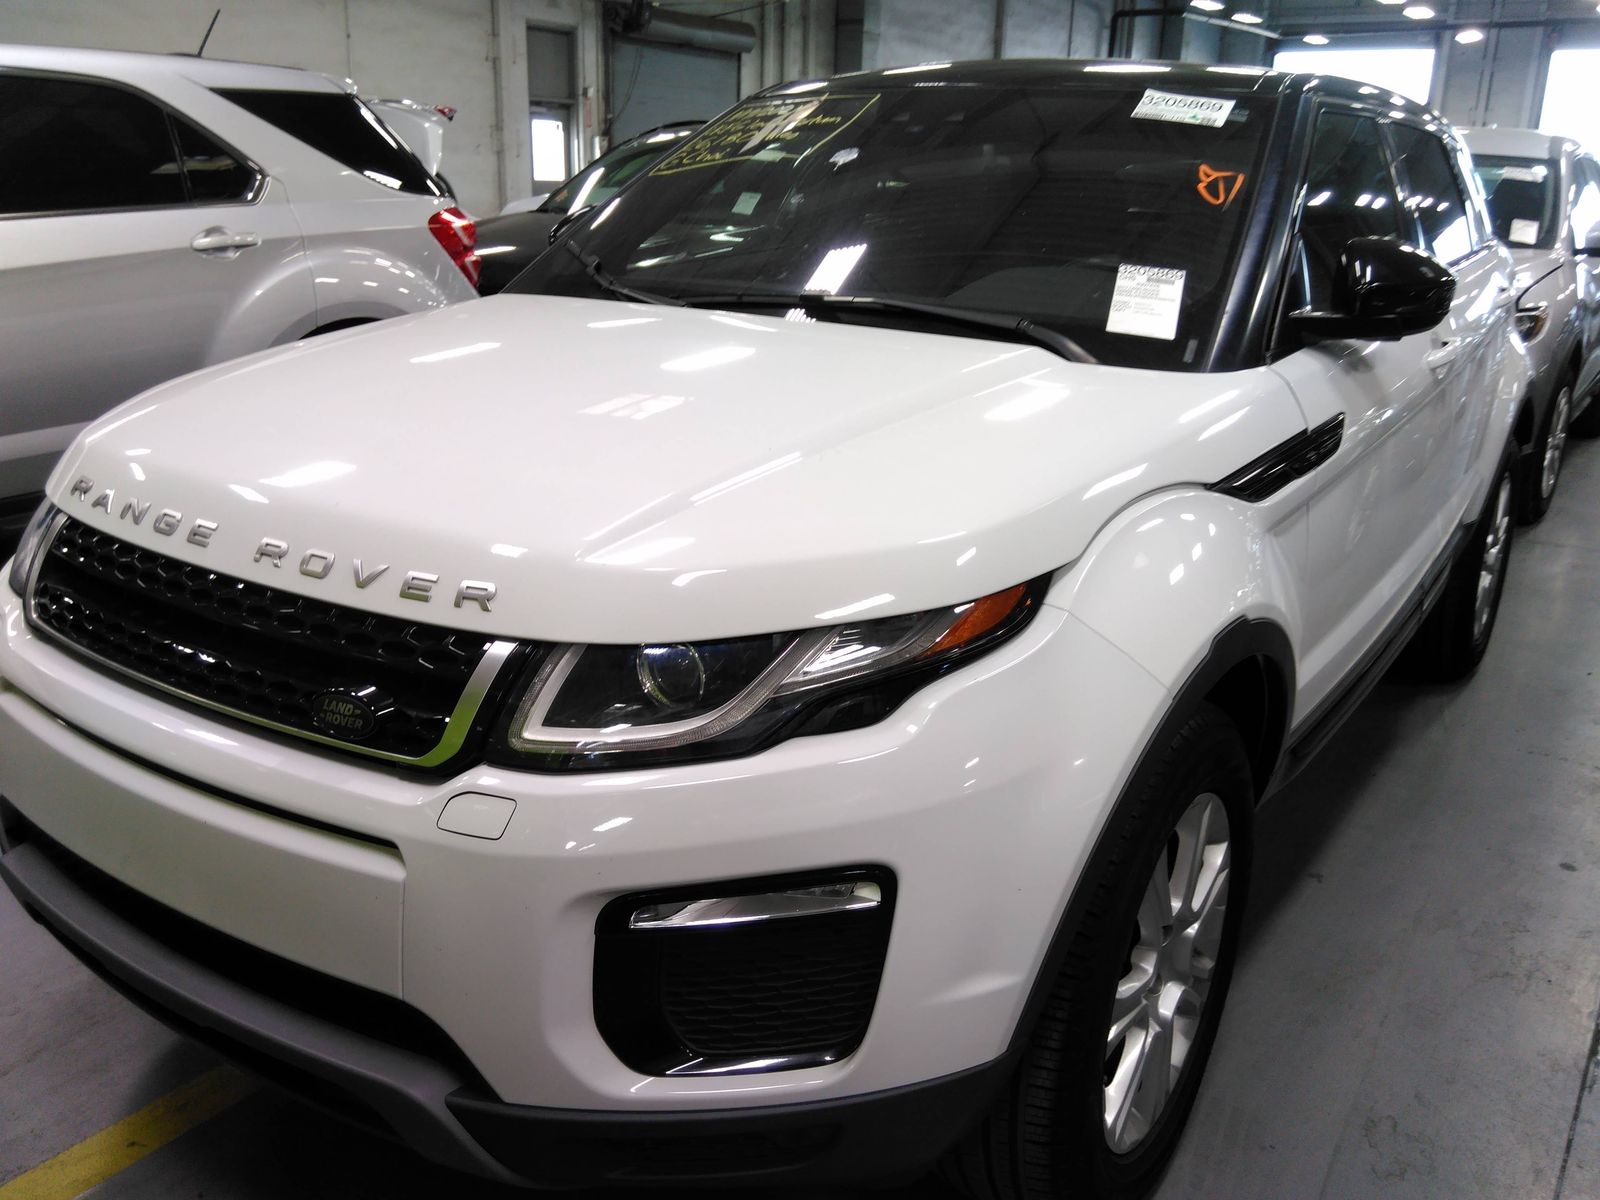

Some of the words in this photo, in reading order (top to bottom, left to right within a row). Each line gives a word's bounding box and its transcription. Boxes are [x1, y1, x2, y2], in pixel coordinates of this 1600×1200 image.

[71, 475, 219, 548] RANGE
[253, 536, 497, 612] ROVER
[323, 699, 353, 715] LAND
[326, 712, 363, 728] ROVER
